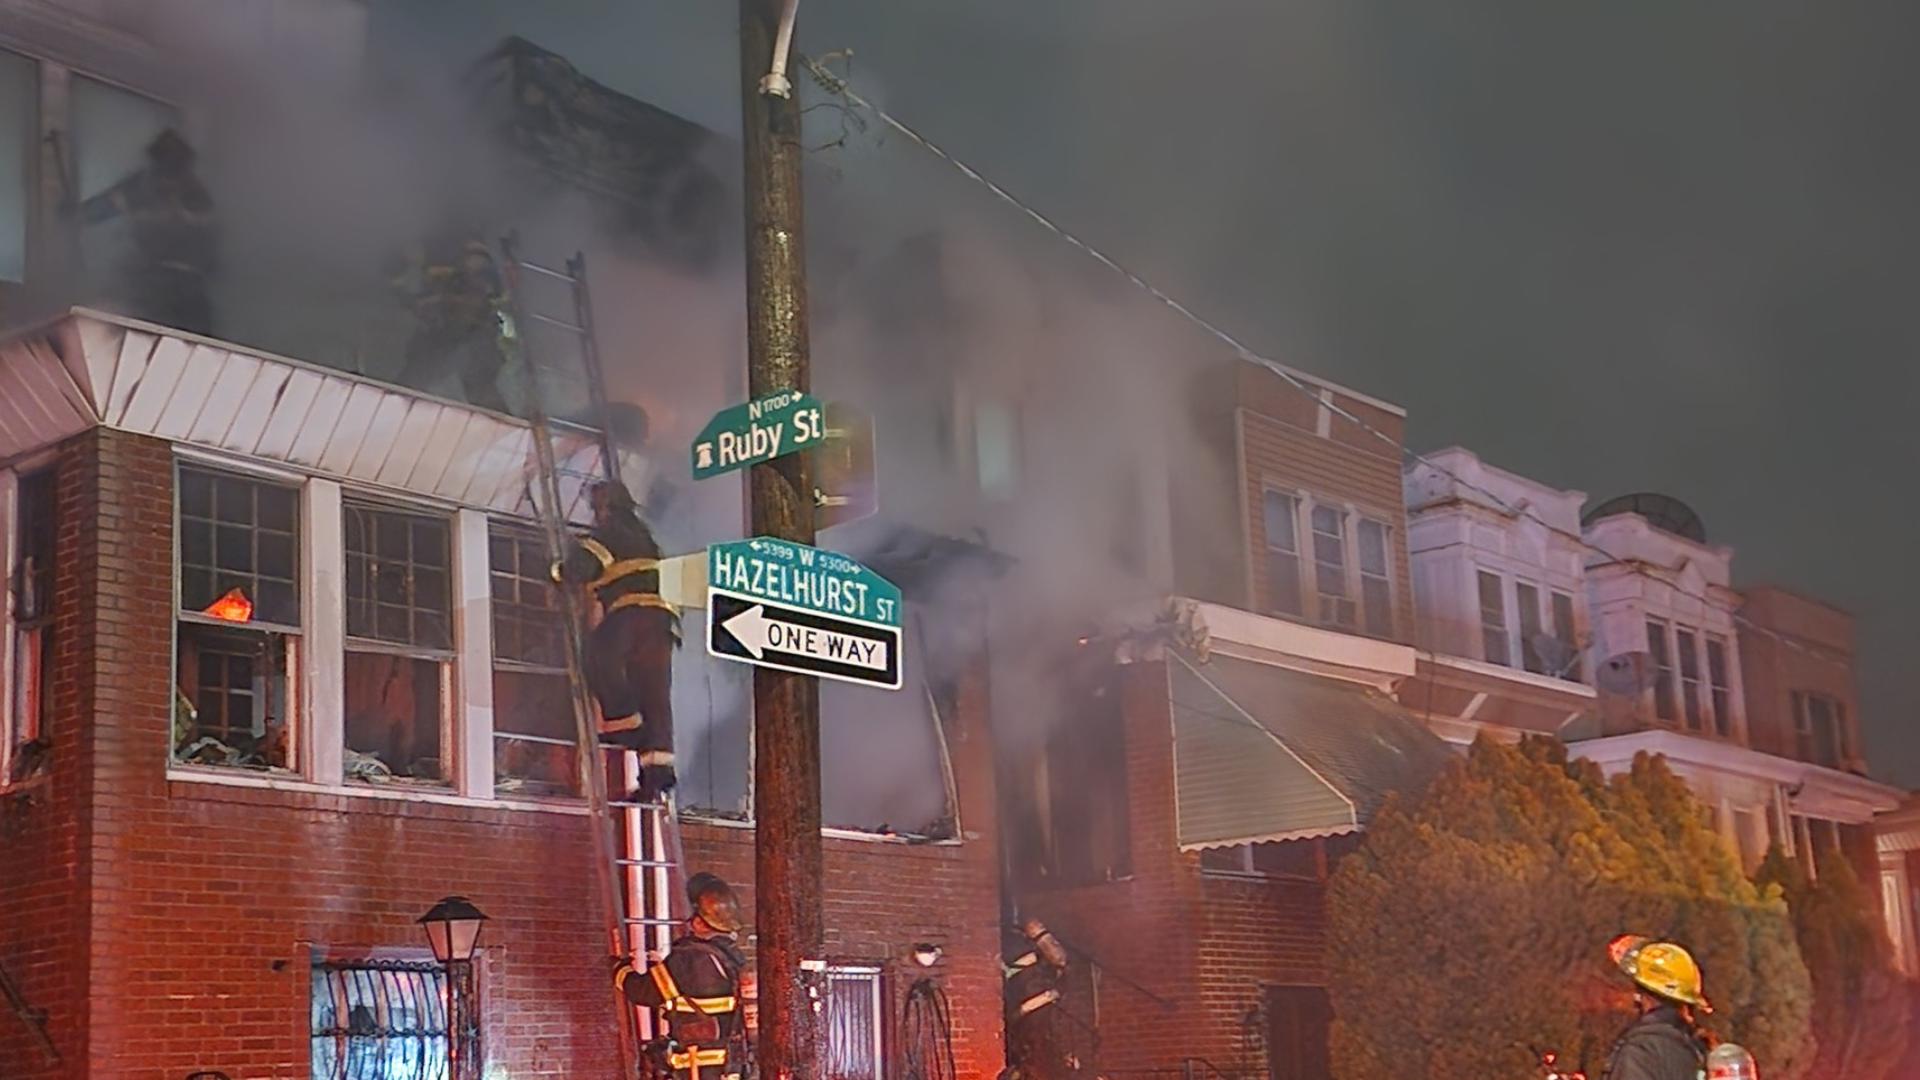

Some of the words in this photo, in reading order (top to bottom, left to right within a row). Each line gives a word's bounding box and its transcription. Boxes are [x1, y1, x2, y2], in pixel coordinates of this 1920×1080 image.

[749, 401, 762, 420] N
[763, 394, 790, 412] 1700
[718, 423, 784, 467] Ruby
[792, 408, 821, 442] St
[799, 548, 815, 567] W
[819, 556, 851, 573] 5300
[714, 549, 869, 616] HAZELHURST
[876, 598, 895, 622] ST
[767, 623, 818, 654] ONE
[827, 635, 877, 664] WAY
